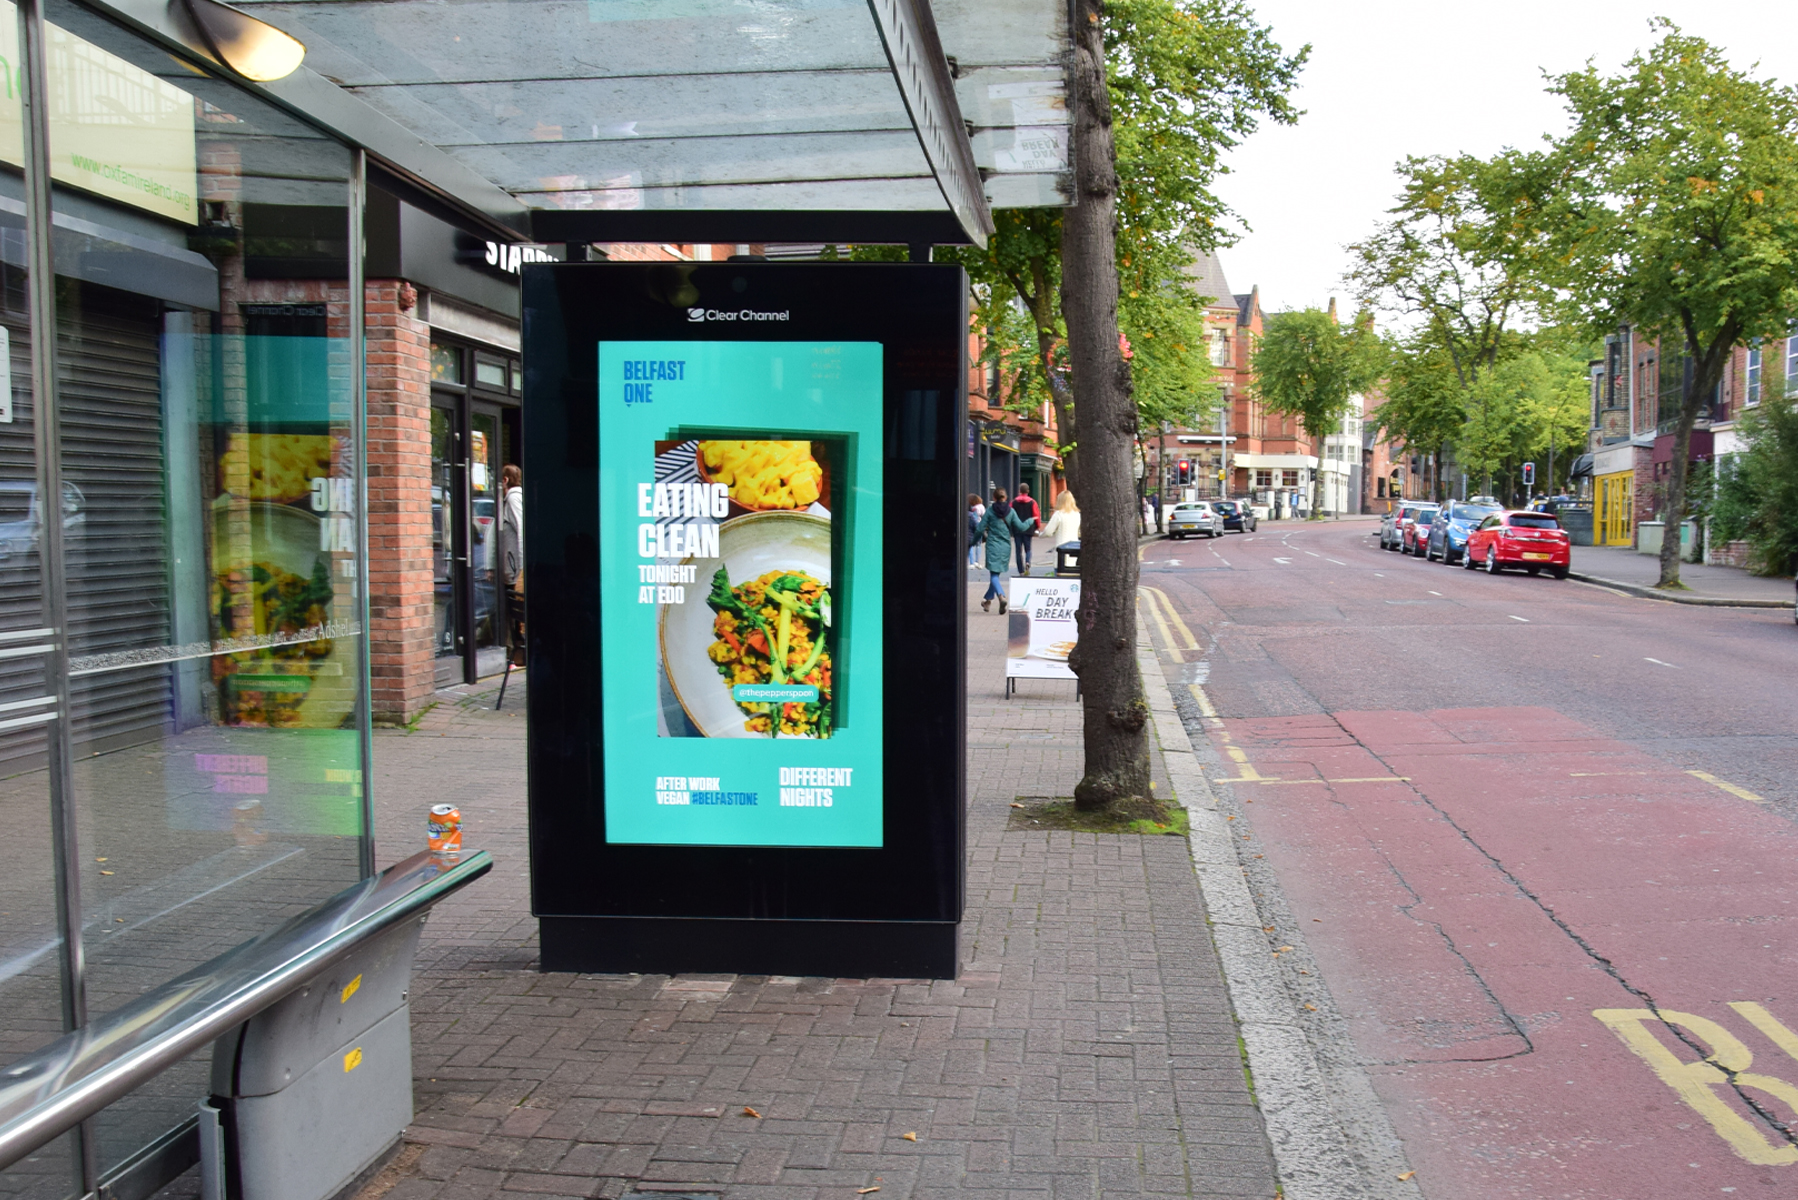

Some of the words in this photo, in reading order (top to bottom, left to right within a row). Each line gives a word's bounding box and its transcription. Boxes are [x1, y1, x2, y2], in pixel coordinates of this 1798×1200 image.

[705, 309, 738, 321] Clear
[740, 309, 790, 321] Channel
[623, 360, 686, 381] BELFAST
[623, 383, 653, 404] ONE
[637, 482, 729, 518] EATING
[637, 523, 720, 559] CLEAN
[638, 565, 697, 583] TONIGHT
[638, 586, 656, 604] AT
[657, 586, 685, 604] EDO
[1035, 588, 1059, 596] HELLO
[1046, 597, 1069, 607] DAY
[1035, 608, 1073, 619] BREAK
[739, 689, 814, 698] @thepepperspoon
[655, 777, 687, 791] AFTER
[688, 777, 721, 791] WORK
[778, 767, 853, 786] DIFFERENT
[655, 791, 690, 805] VEGAN
[691, 792, 758, 806] #BELFASTONE
[779, 788, 833, 807] NIGHTS
